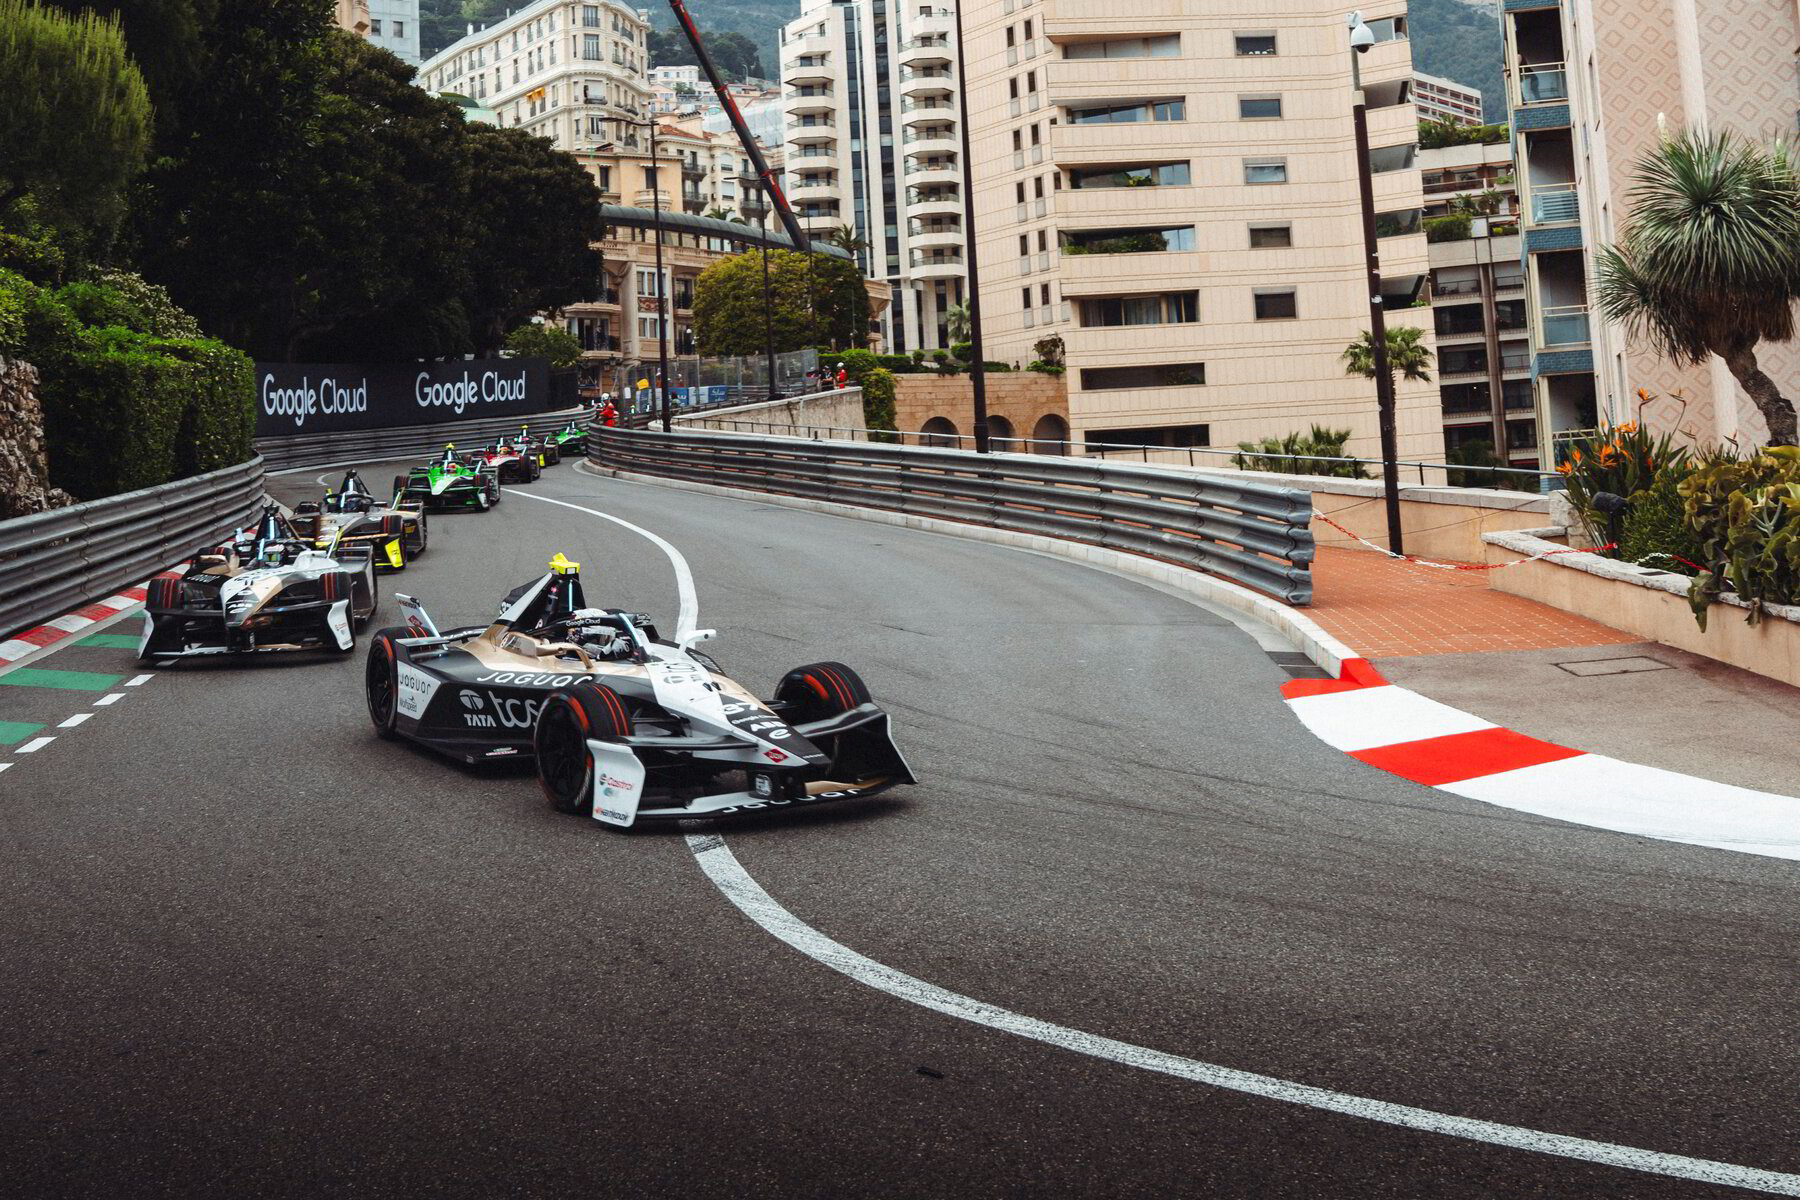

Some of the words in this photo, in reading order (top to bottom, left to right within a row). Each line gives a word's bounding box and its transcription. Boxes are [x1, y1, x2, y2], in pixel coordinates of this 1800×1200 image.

[263, 373, 317, 426] Google
[320, 377, 367, 414] Cloud
[415, 371, 478, 415] Google
[482, 370, 526, 403] Cloud
[565, 619, 585, 627] Google
[463, 713, 497, 727] TATA
